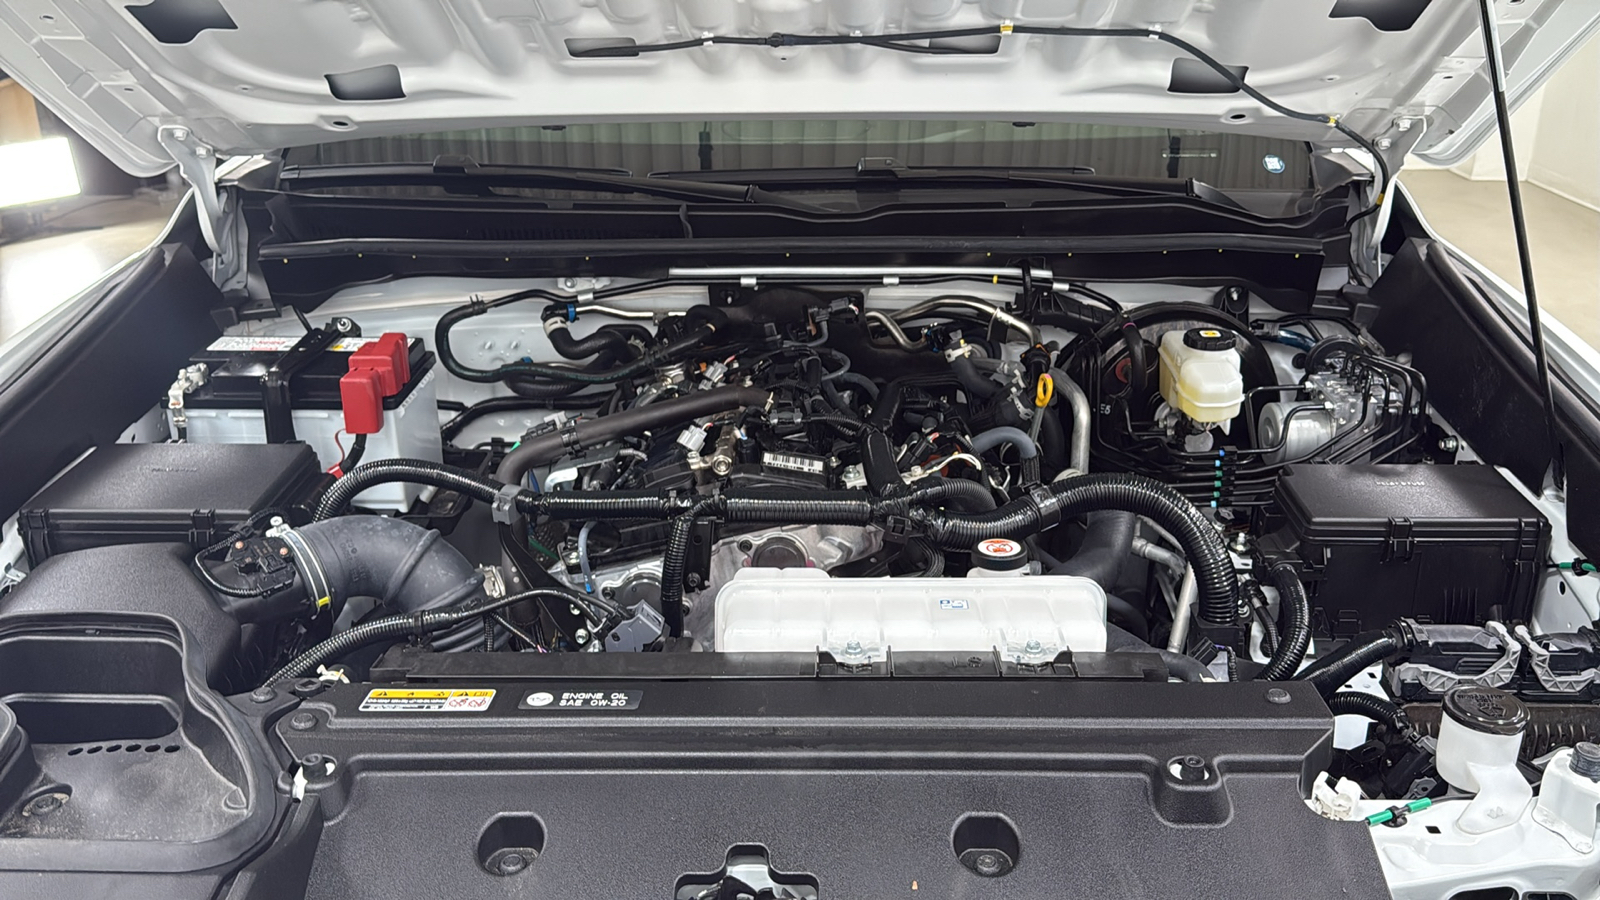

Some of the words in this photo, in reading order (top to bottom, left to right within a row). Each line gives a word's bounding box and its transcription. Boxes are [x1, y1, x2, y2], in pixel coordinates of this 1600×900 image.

[561, 692, 604, 700] ENGINE
[610, 692, 629, 700] OIL
[559, 699, 584, 707] SAE
[590, 699, 626, 707] 0W-20
